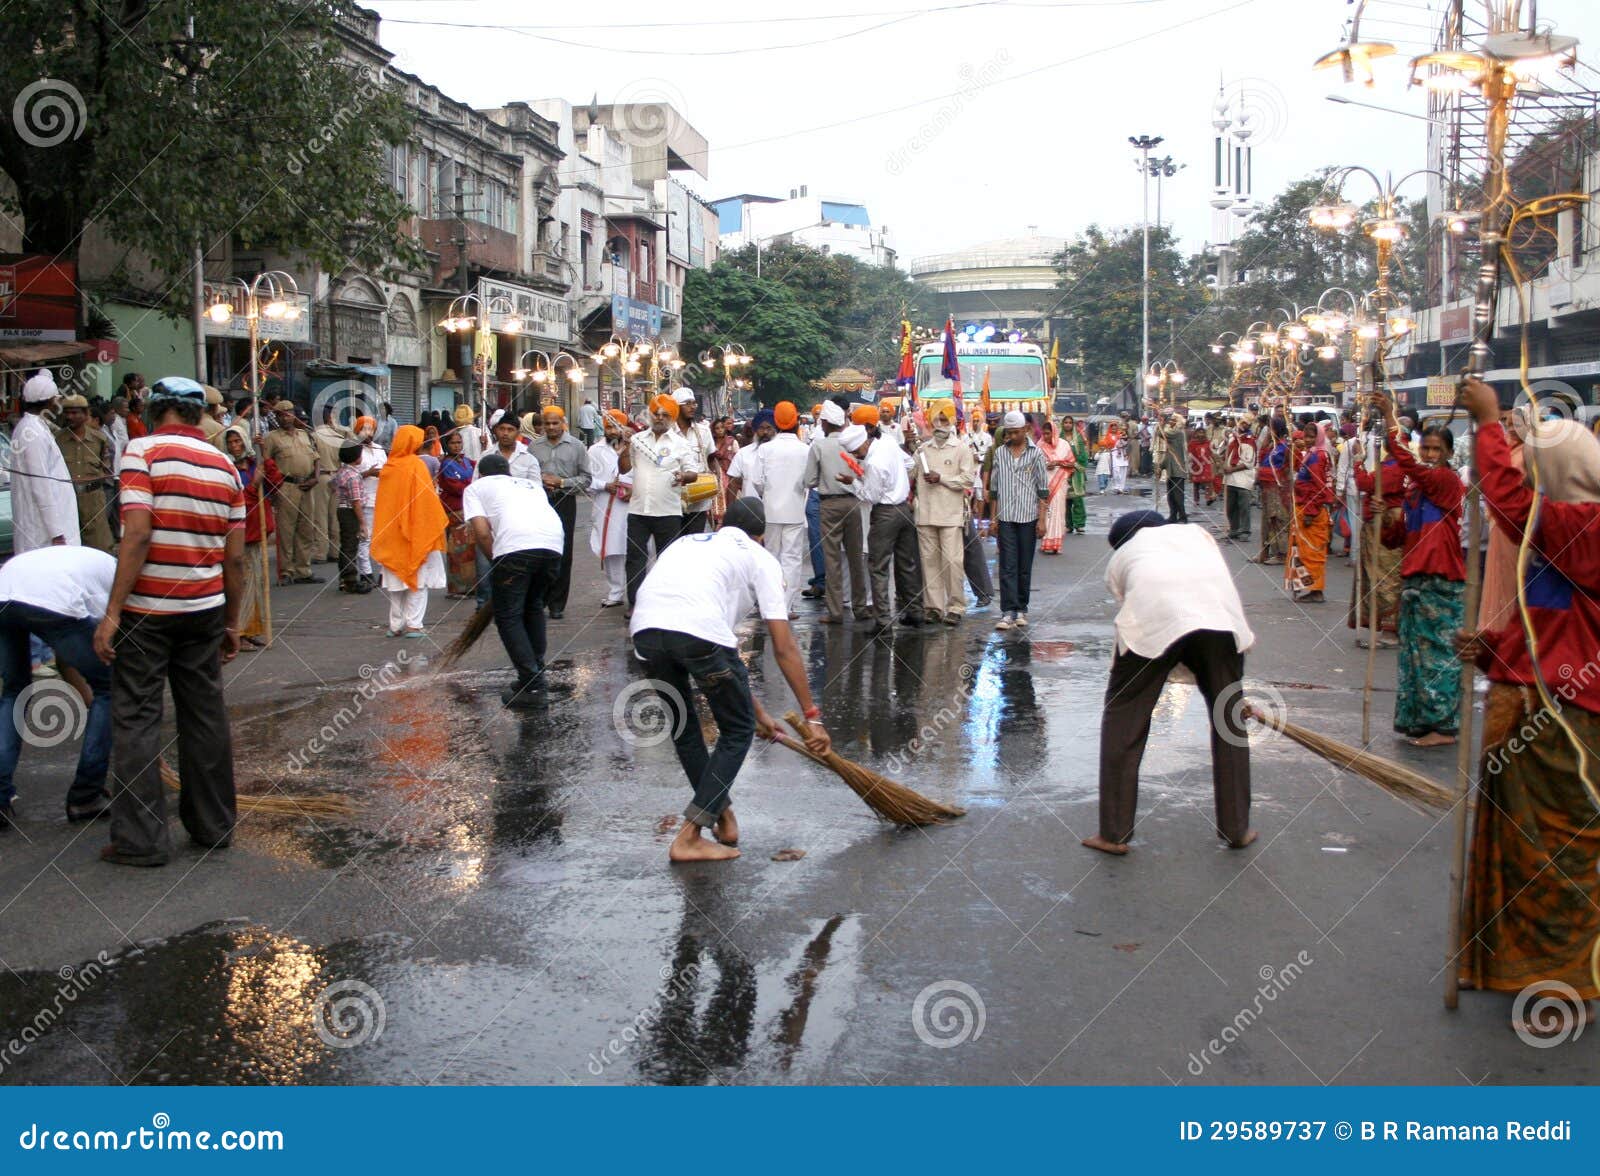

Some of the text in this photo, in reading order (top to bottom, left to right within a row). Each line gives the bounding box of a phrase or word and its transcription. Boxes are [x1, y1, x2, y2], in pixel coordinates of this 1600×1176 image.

[3, 329, 19, 337] PAN
[958, 347, 970, 355] ALL
[990, 348, 1010, 356] PERMIT
